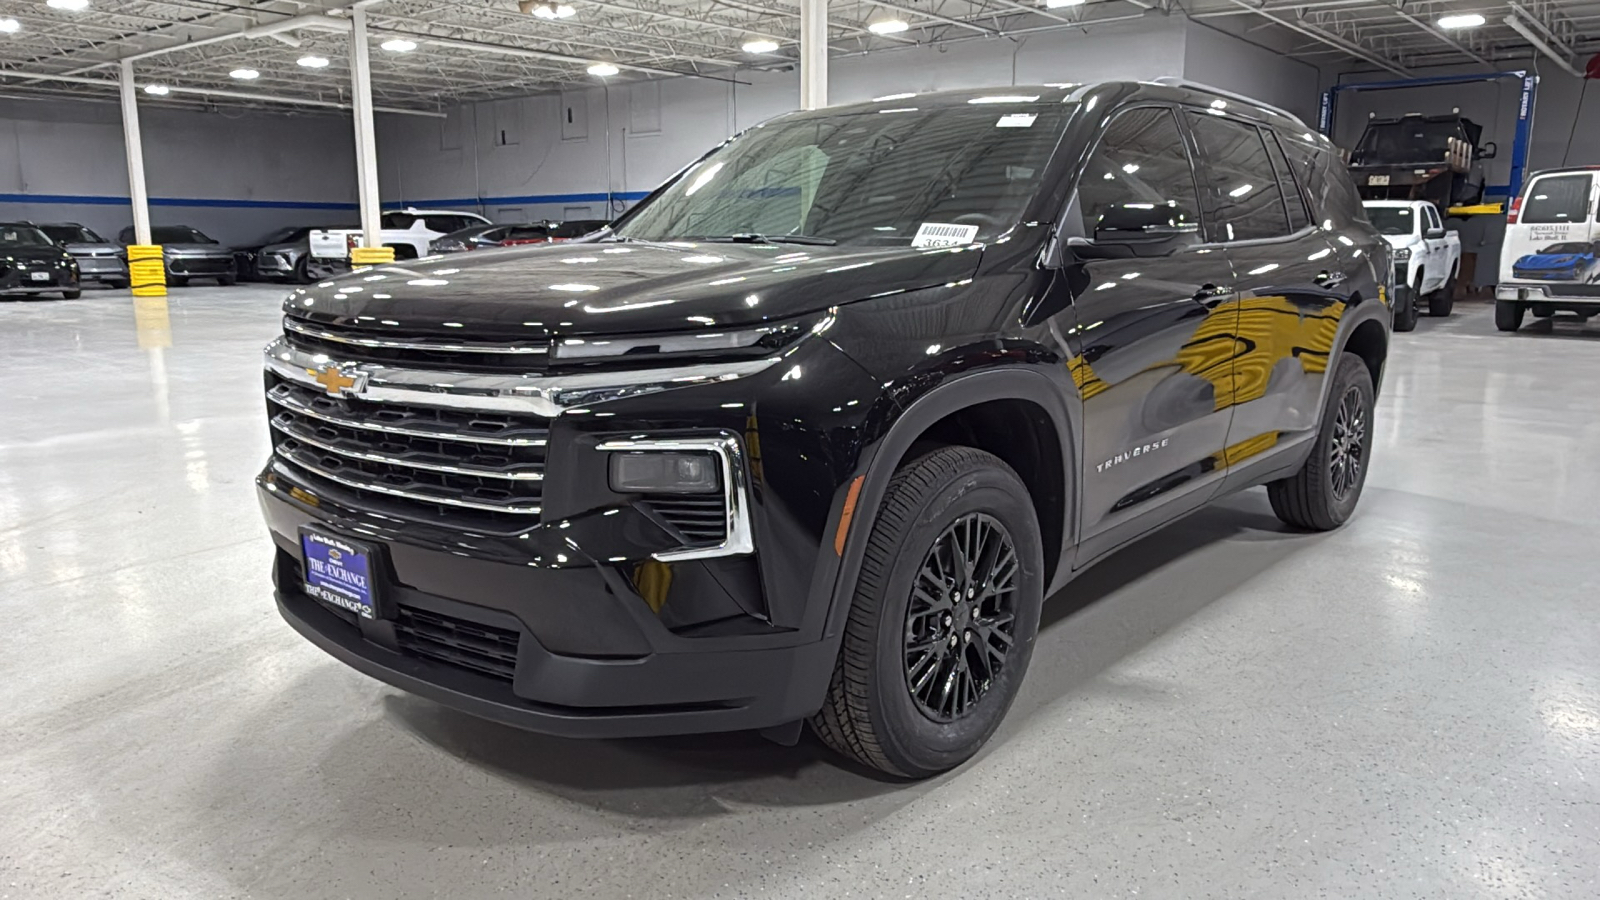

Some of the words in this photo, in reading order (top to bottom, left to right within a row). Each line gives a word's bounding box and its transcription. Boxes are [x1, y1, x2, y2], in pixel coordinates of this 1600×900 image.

[1096, 438, 1169, 473] TRAVERSE
[308, 557, 326, 573] THE
[327, 563, 367, 589] EXCHANGE
